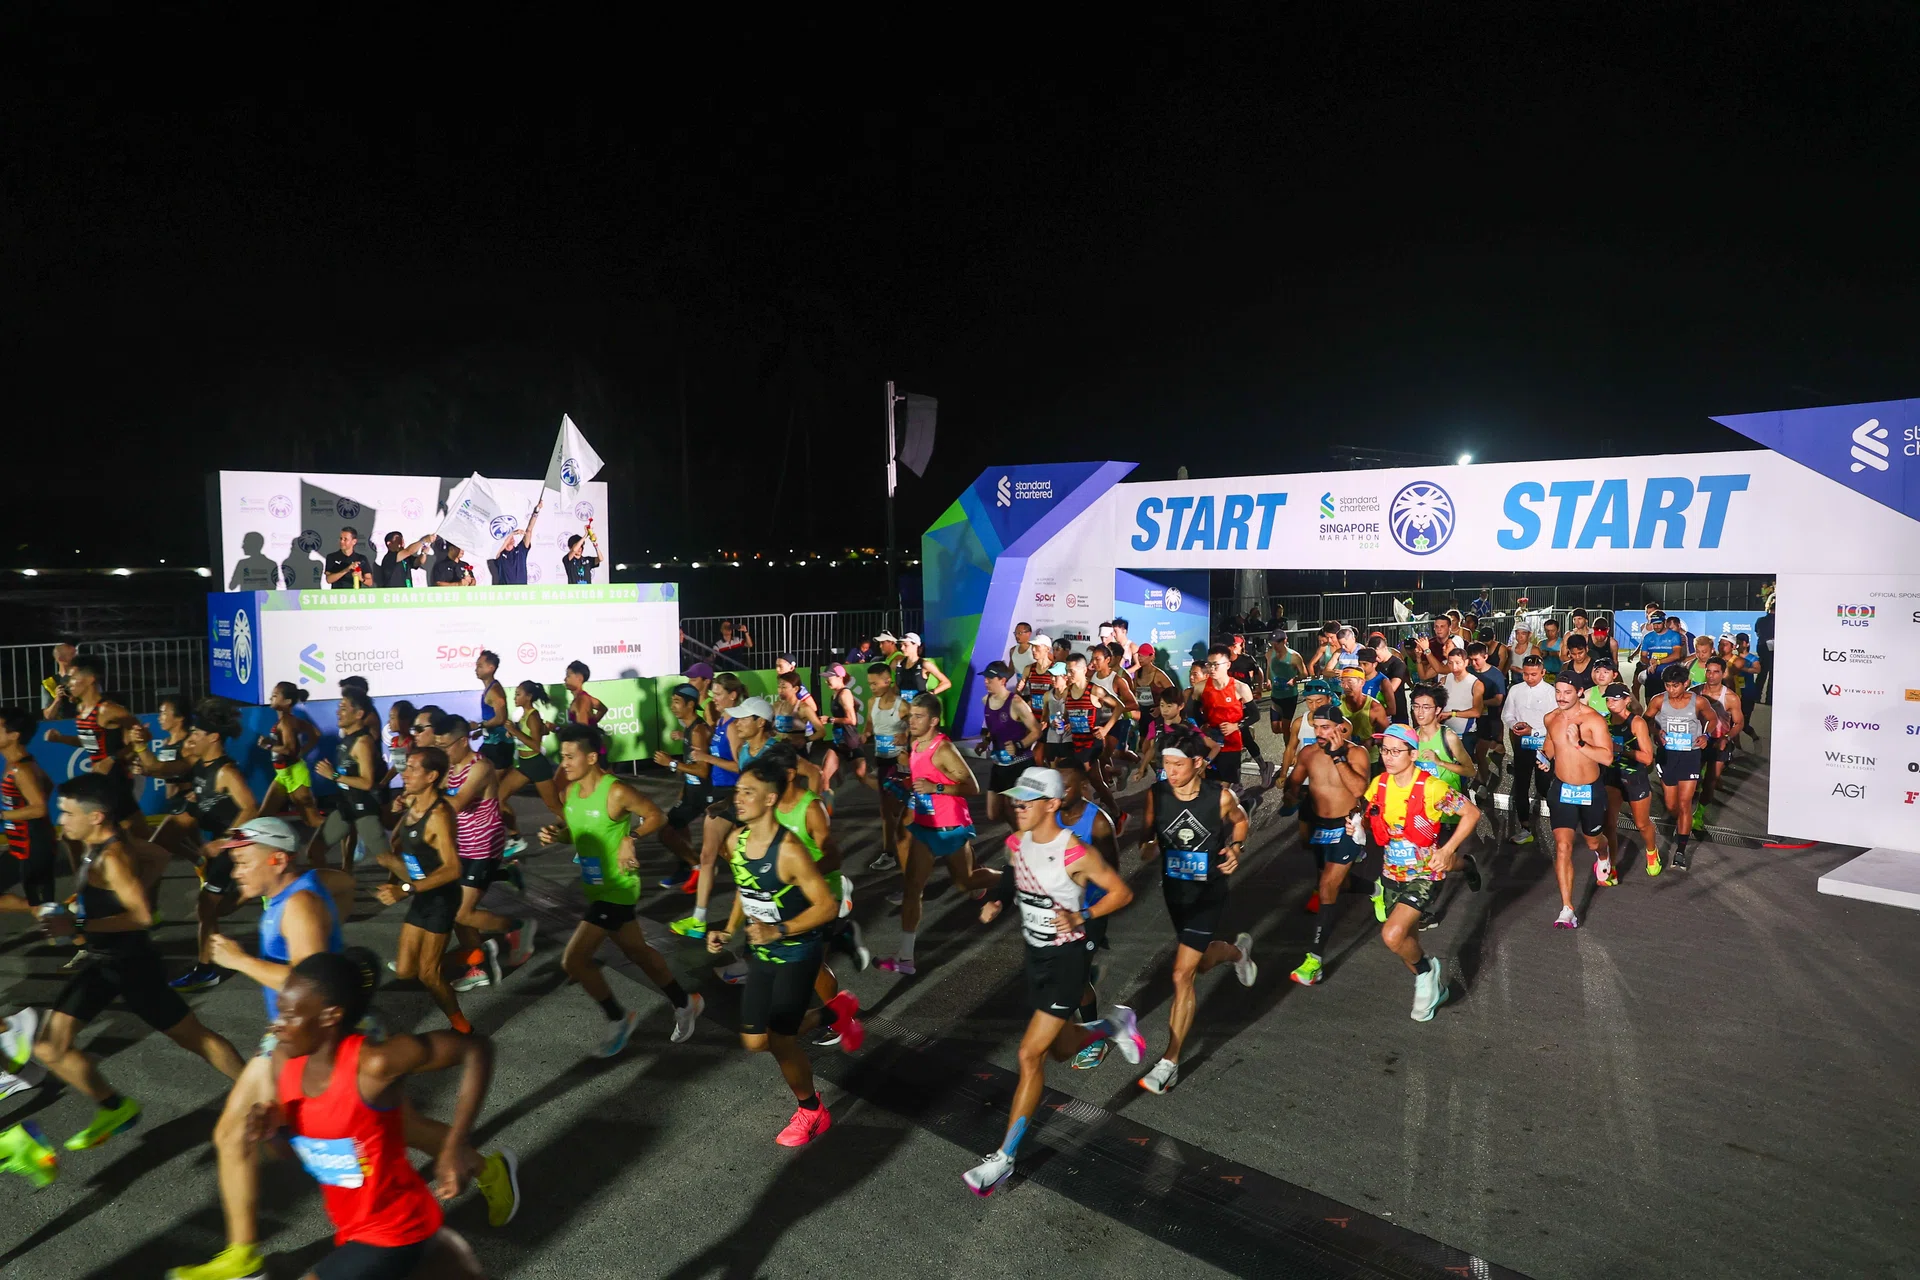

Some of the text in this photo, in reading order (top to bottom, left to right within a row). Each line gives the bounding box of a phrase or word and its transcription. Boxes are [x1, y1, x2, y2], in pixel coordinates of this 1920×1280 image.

[1015, 480, 1050, 490] standard
[1015, 489, 1053, 499] chartered
[1340, 495, 1378, 505] standard
[1340, 502, 1380, 513] chartered
[1496, 474, 1751, 550] START
[1131, 492, 1288, 551] START
[1319, 523, 1380, 534] SINGAPORE
[302, 593, 376, 605] STANDARD
[383, 591, 460, 603] CHARTERED
[609, 589, 637, 599] 2024
[1035, 593, 1056, 602] Sport
[1063, 633, 1091, 642] IRONMAN
[520, 649, 535, 658] SG
[593, 641, 642, 655] IRONMAN
[335, 648, 399, 661] standard
[1823, 648, 1847, 662] tcs
[335, 660, 404, 673] chartered
[439, 661, 478, 670] SINGAPO
[1822, 683, 1842, 696] VQ
[1669, 724, 1686, 732] NB
[1842, 721, 1880, 731] JOYVIO
[1825, 751, 1876, 766] WESTIN
[1561, 789, 1592, 798] A1228
[1832, 783, 1866, 799] AG1
[1167, 857, 1206, 871] A1116
